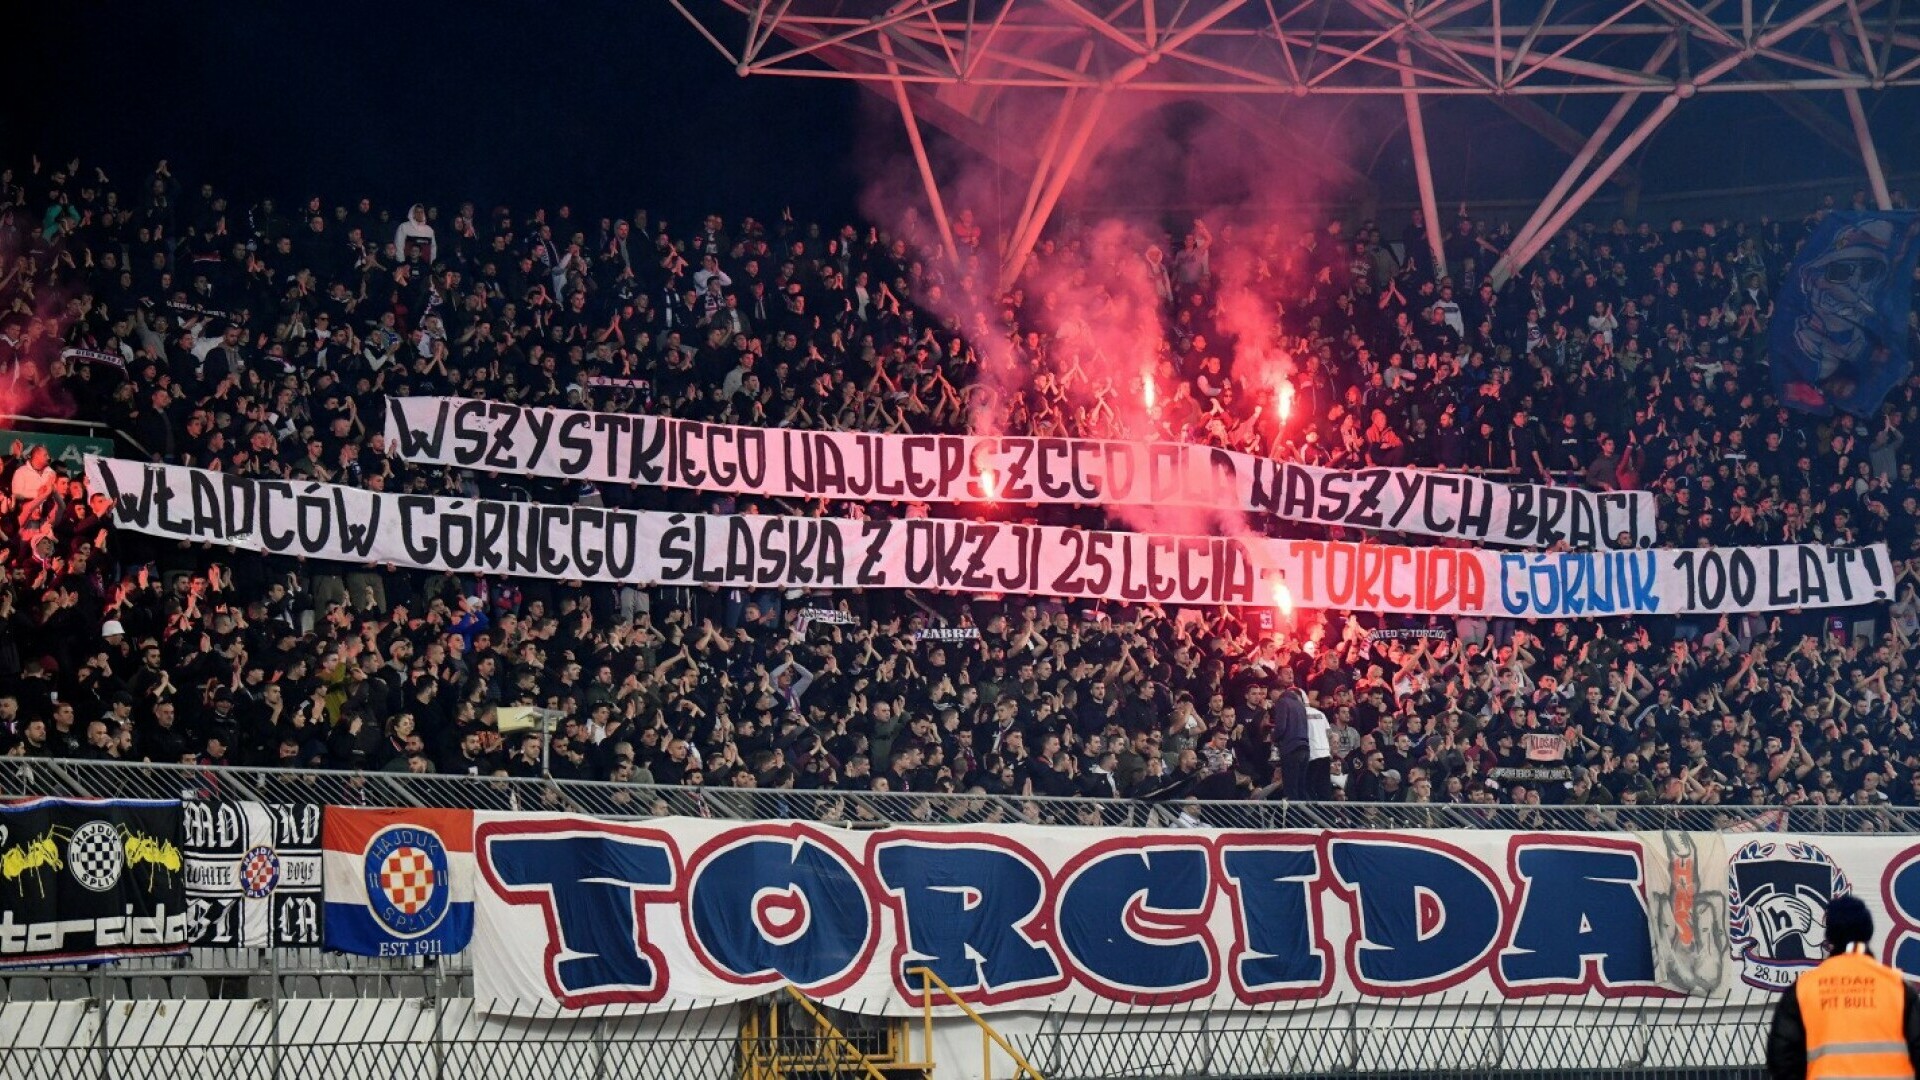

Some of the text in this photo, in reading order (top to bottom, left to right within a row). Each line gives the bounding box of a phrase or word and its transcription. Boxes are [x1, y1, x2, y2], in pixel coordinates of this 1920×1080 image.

[393, 400, 765, 489] WSZYSTKIEGO
[784, 431, 1133, 500] NAJLEPSZEGO
[1150, 442, 1238, 506] DLA
[1250, 458, 1494, 537] NASZYCH
[98, 459, 382, 556] WŁADCÓW
[402, 494, 637, 579] GÓRNEGO
[857, 519, 892, 585] Z
[905, 520, 1041, 595] OKZJI
[1290, 541, 1486, 611] TORCIDA
[1500, 551, 1660, 615] GÓRNIK
[1674, 550, 1756, 610] 100
[1769, 545, 1888, 608] LAT!
[372, 830, 439, 861] HAJDUK
[81, 873, 115, 887] SPLIT
[186, 860, 314, 886] WHITE BOYS
[383, 905, 436, 931] SPLIT
[477, 820, 1690, 1008] TORCIDA
[379, 939, 441, 957] EST. 1911
[1754, 964, 1806, 984] 28.10.1
[1818, 976, 1876, 986] REDAR
[1821, 997, 1876, 1010] PIT BULL
